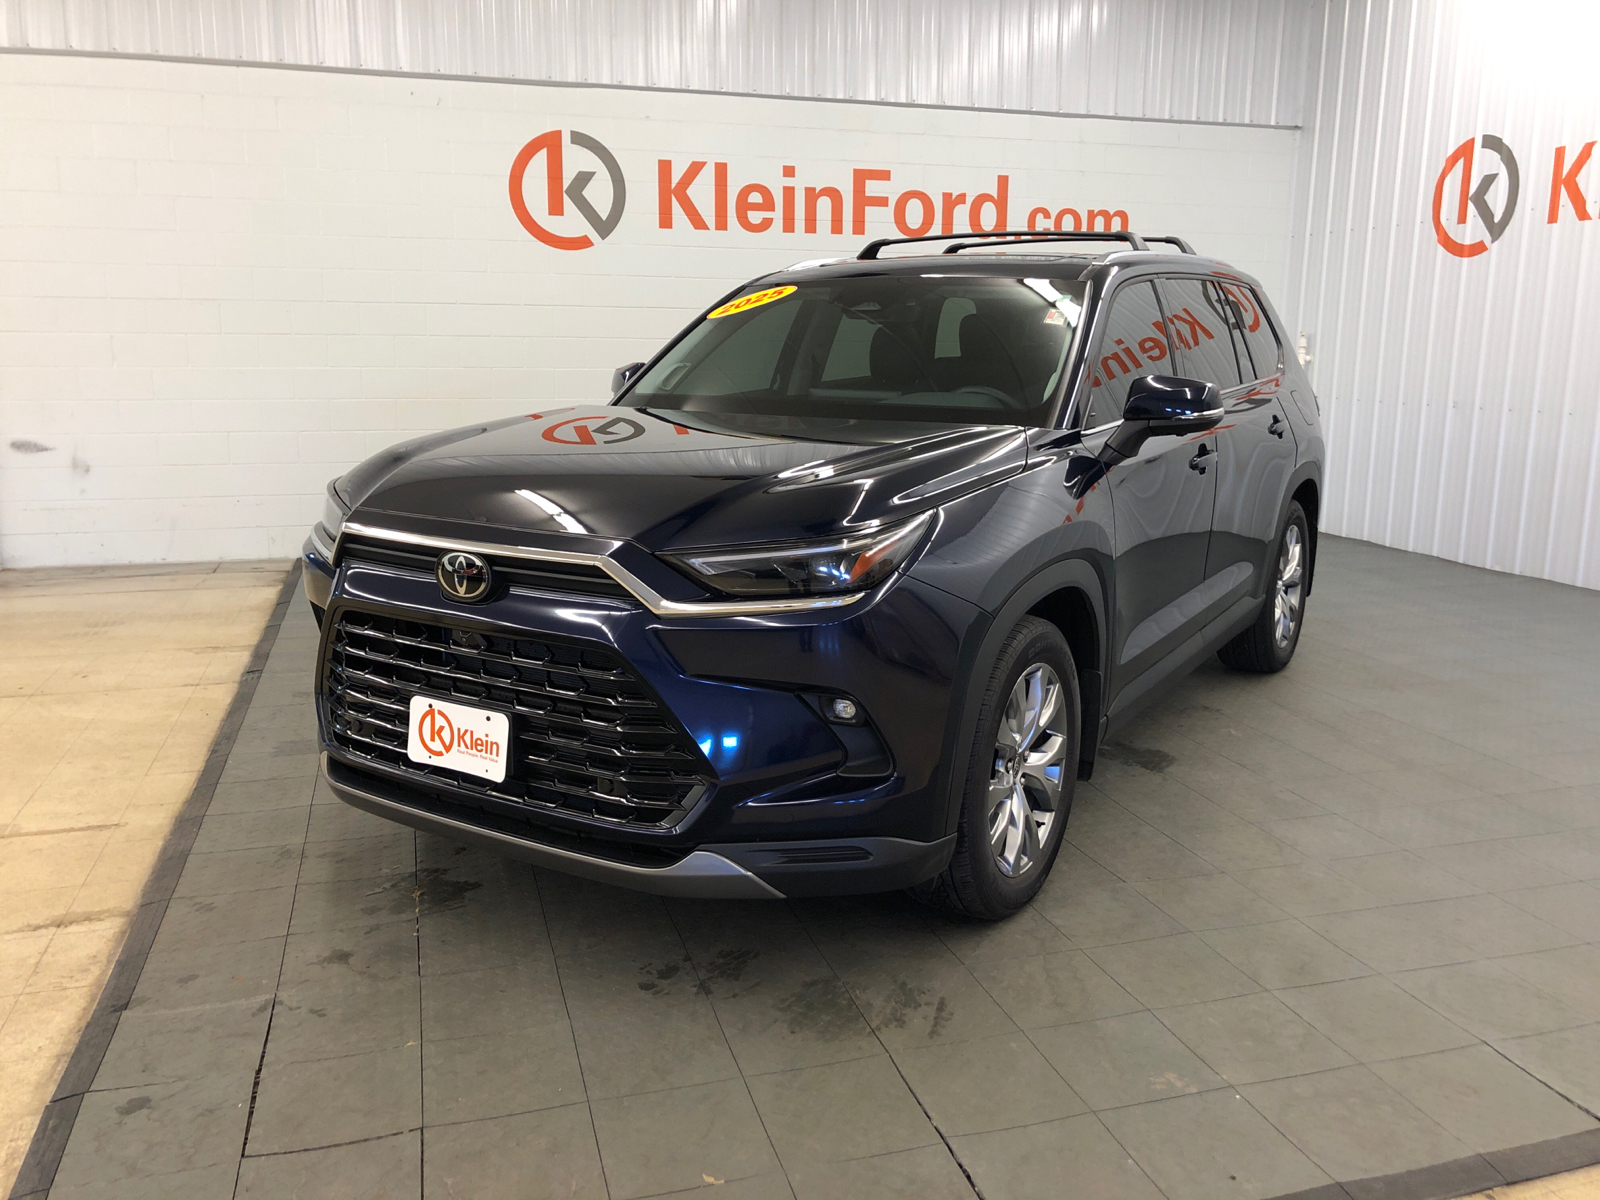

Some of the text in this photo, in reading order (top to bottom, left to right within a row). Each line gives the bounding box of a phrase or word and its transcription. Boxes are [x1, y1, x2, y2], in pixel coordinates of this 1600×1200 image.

[1547, 140, 1600, 225] K
[714, 287, 788, 317] 2025
[457, 727, 500, 758] Klein
